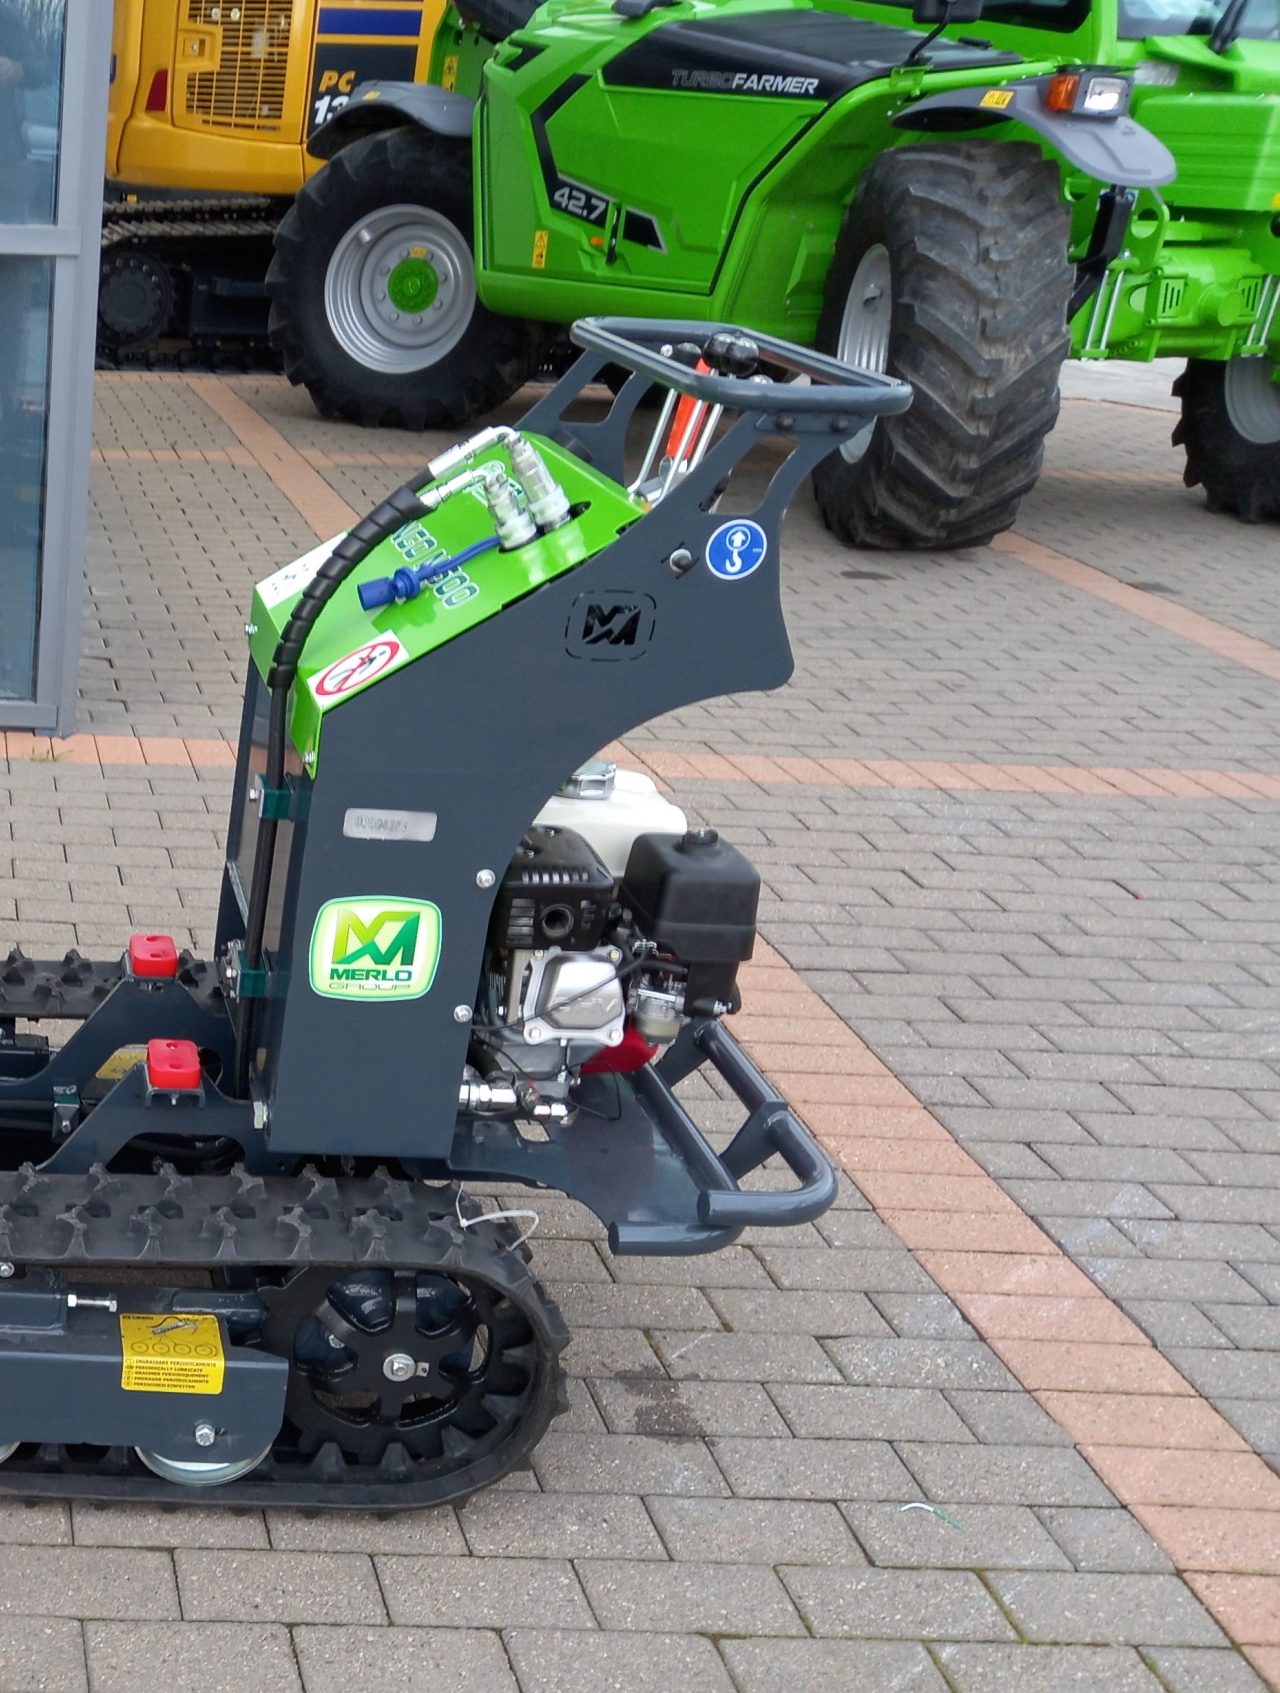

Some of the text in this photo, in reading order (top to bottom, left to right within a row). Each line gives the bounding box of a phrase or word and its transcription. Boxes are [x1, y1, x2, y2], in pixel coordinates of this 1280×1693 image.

[318, 69, 356, 94] PC
[671, 69, 819, 95] TURBOFARMER
[554, 186, 607, 220] 42.7
[329, 968, 413, 982] MERLO
